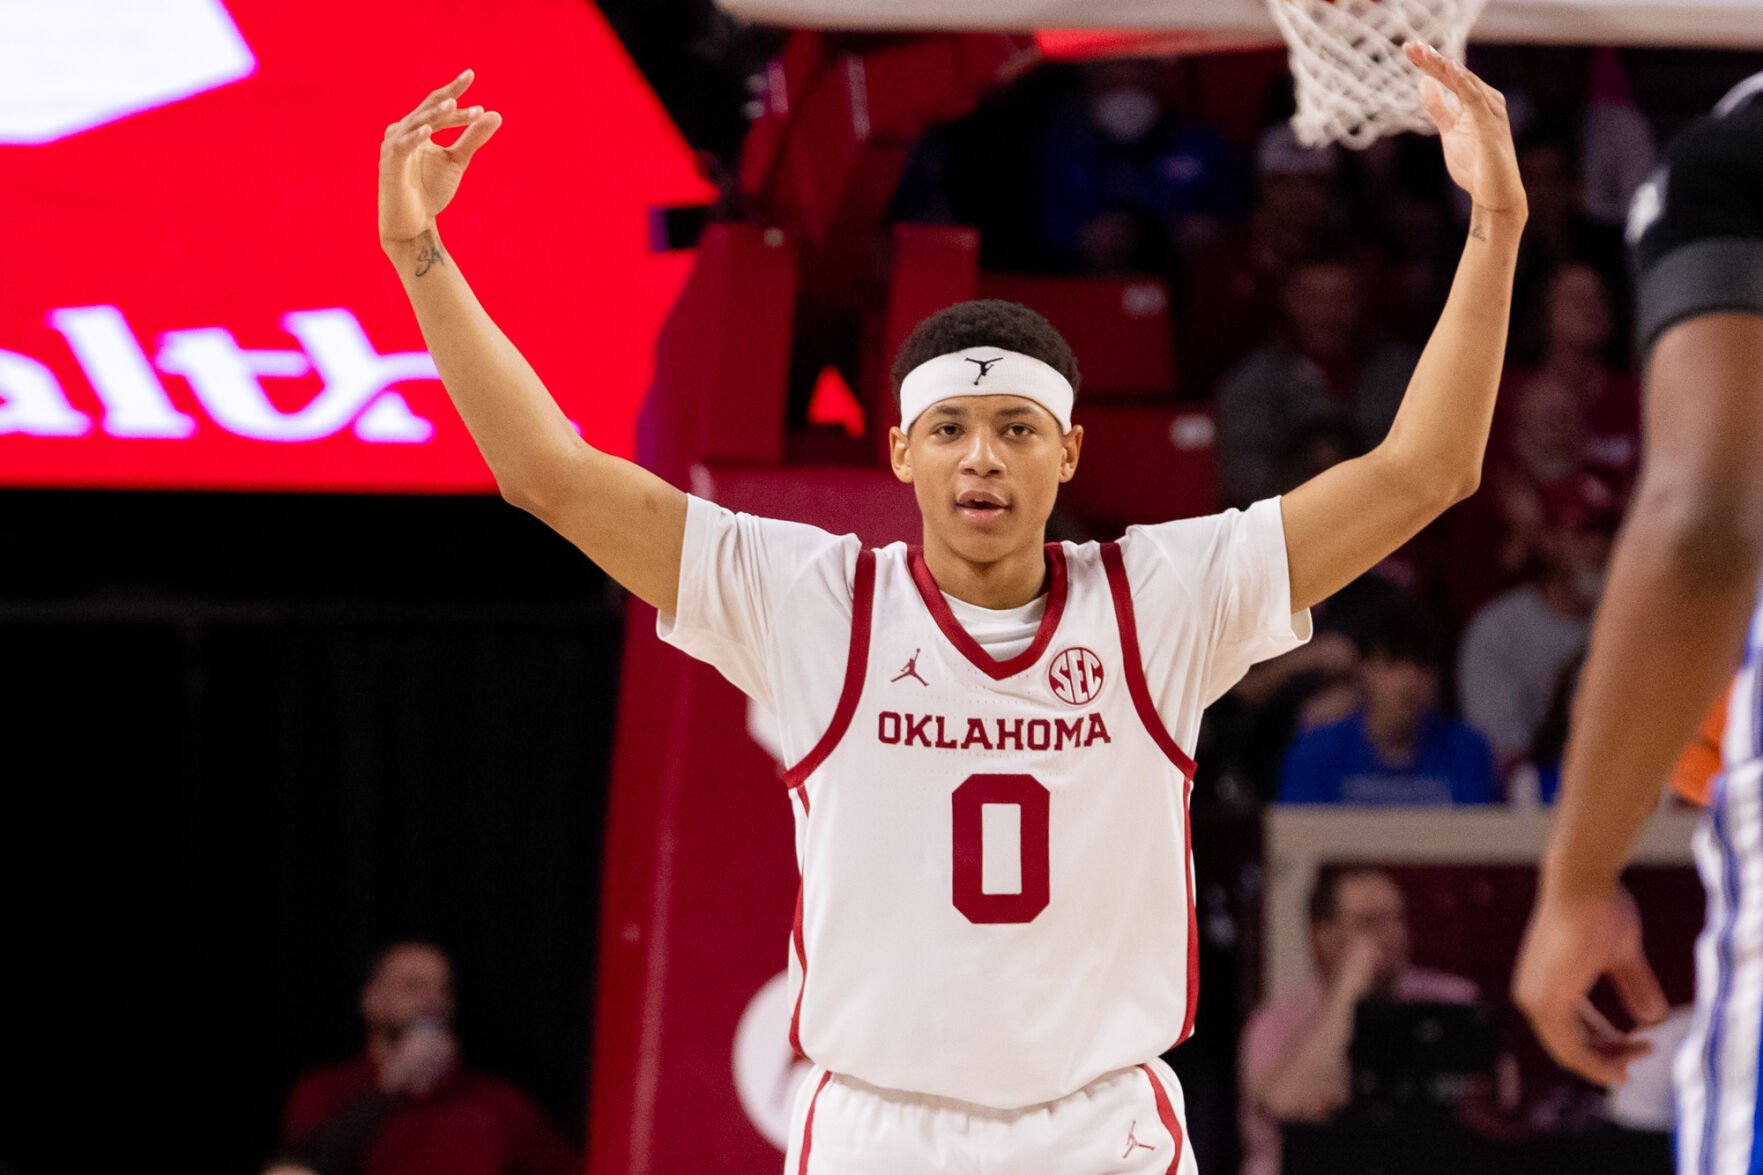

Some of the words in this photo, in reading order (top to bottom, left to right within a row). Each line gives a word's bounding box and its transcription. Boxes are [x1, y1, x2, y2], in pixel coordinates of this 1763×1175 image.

[1049, 647, 1103, 705] SEC
[878, 711, 1111, 751] OKLAHOMA
[952, 774, 1050, 924] 0
